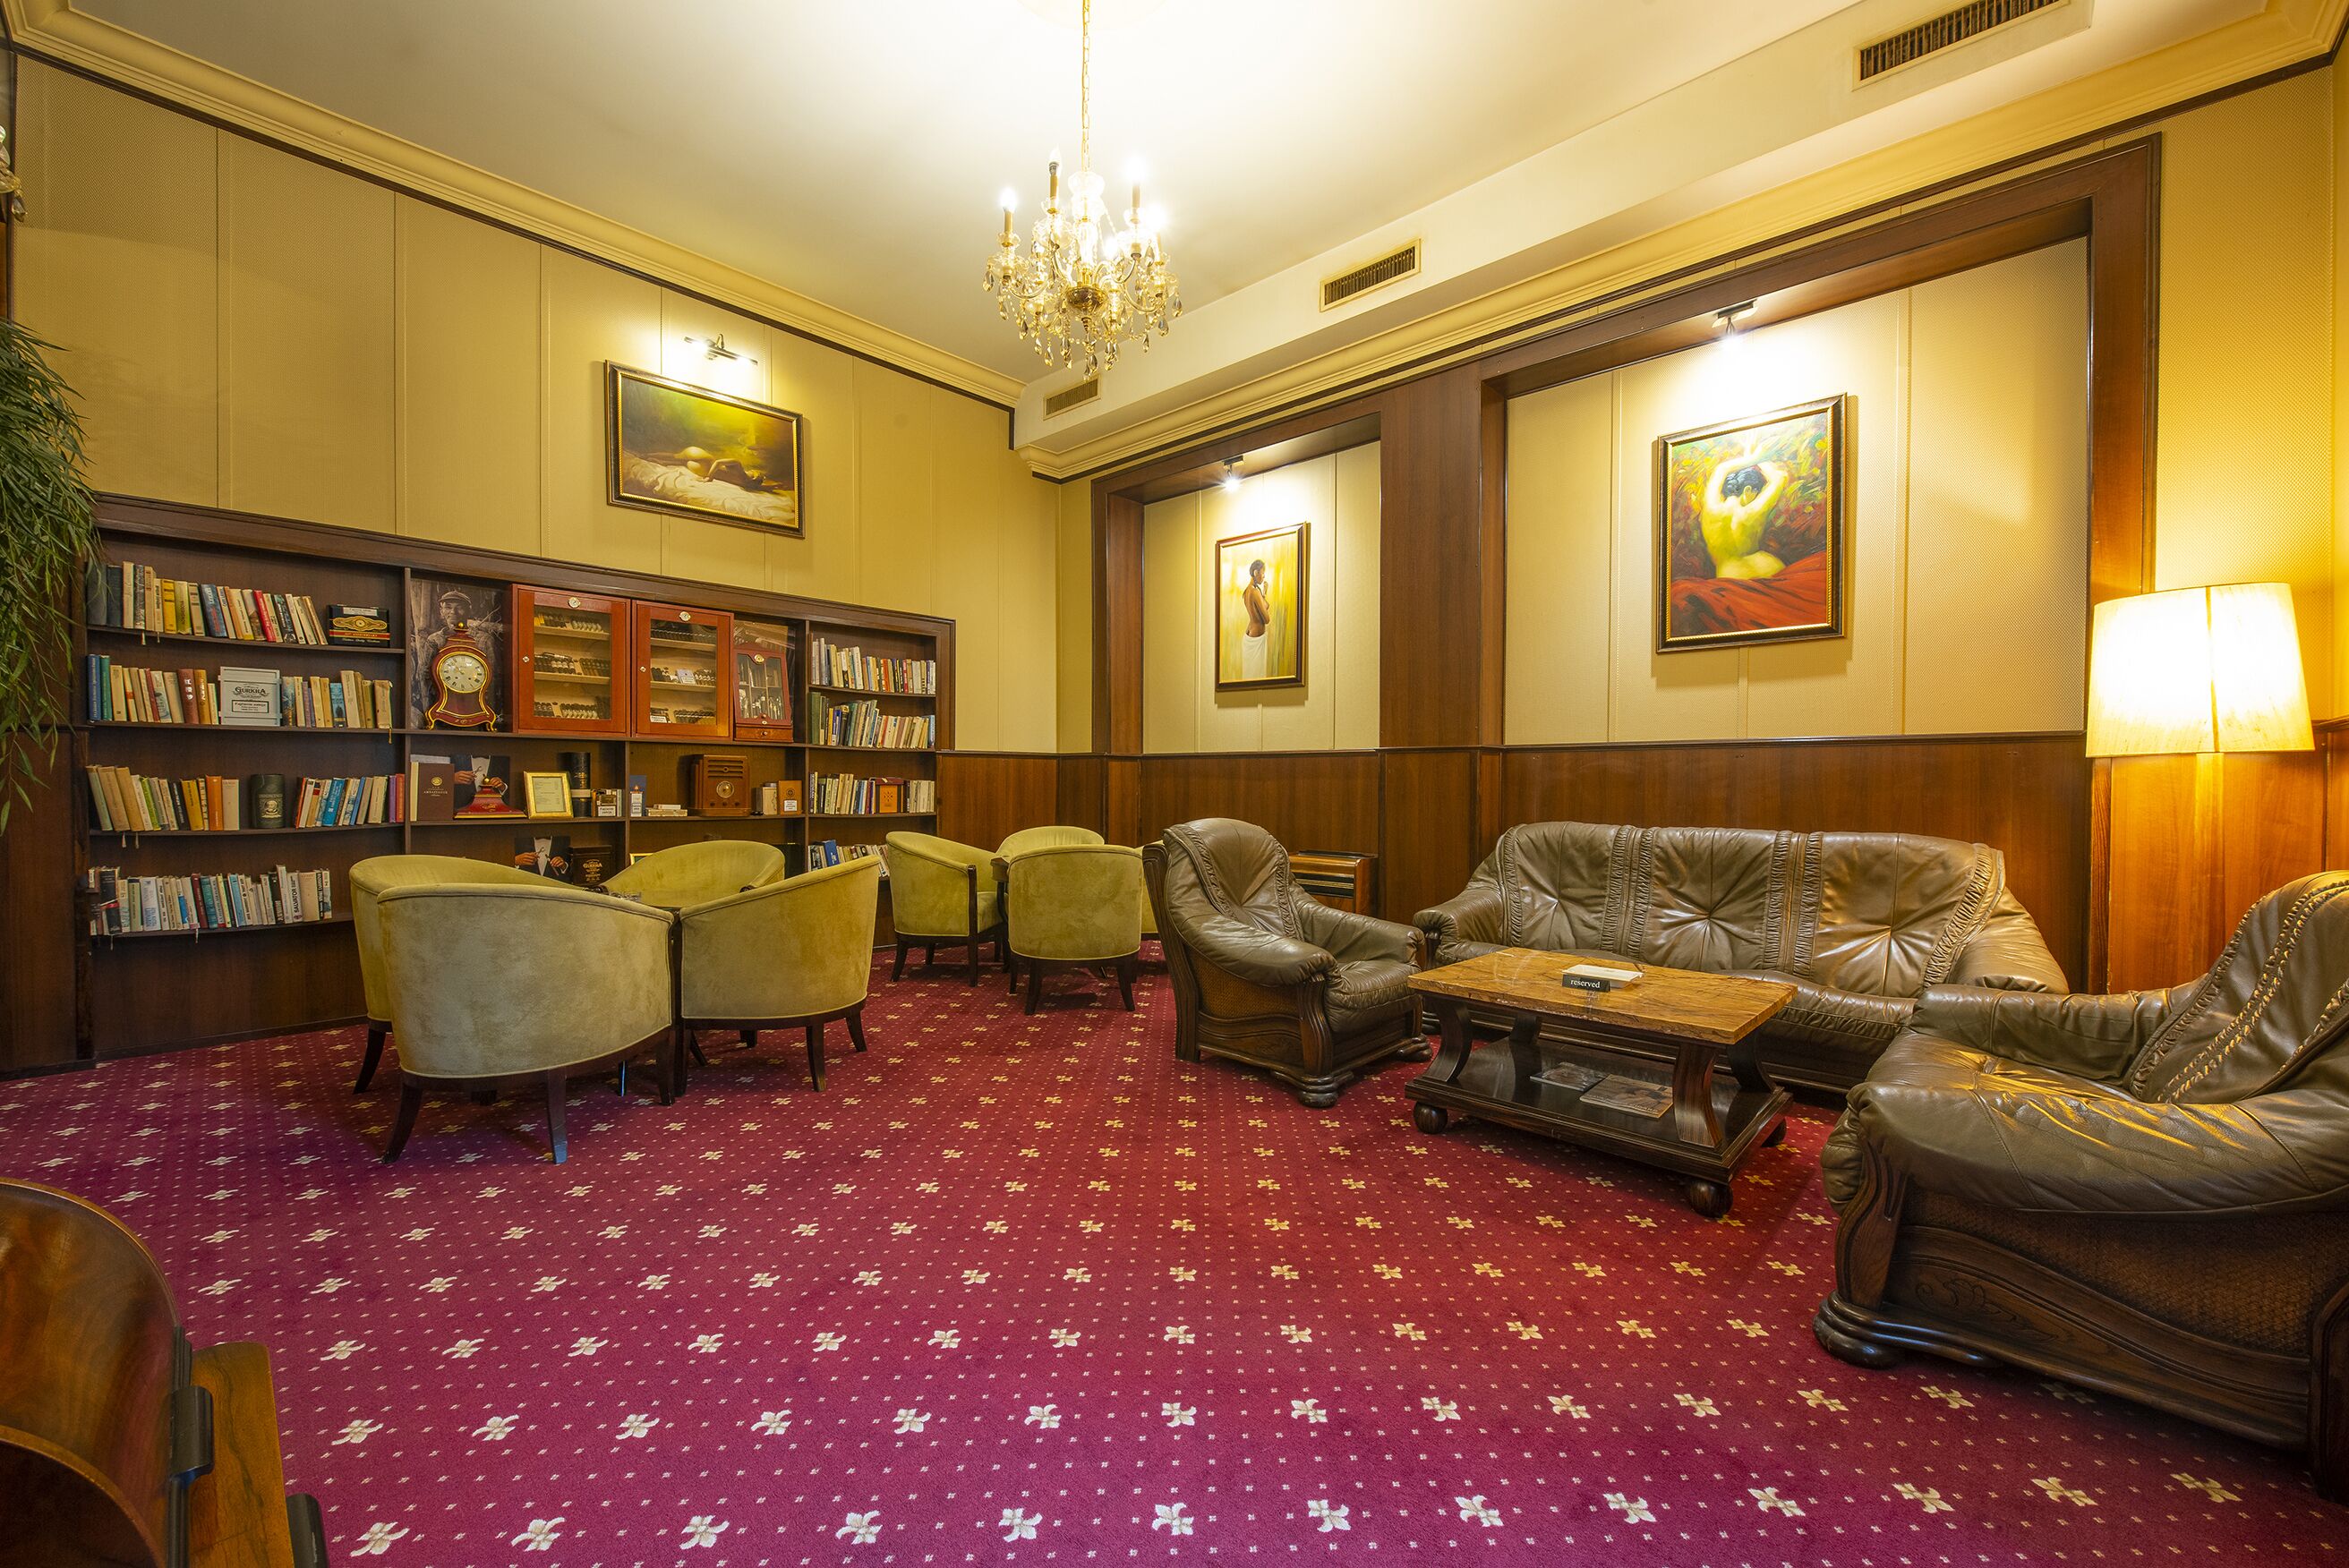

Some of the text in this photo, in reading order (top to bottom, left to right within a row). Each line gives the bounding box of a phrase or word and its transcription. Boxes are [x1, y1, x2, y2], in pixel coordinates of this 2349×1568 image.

[234, 686, 268, 696] GURKHA
[292, 888, 300, 913] SALVATOR
[1570, 979, 1601, 989] reserved
